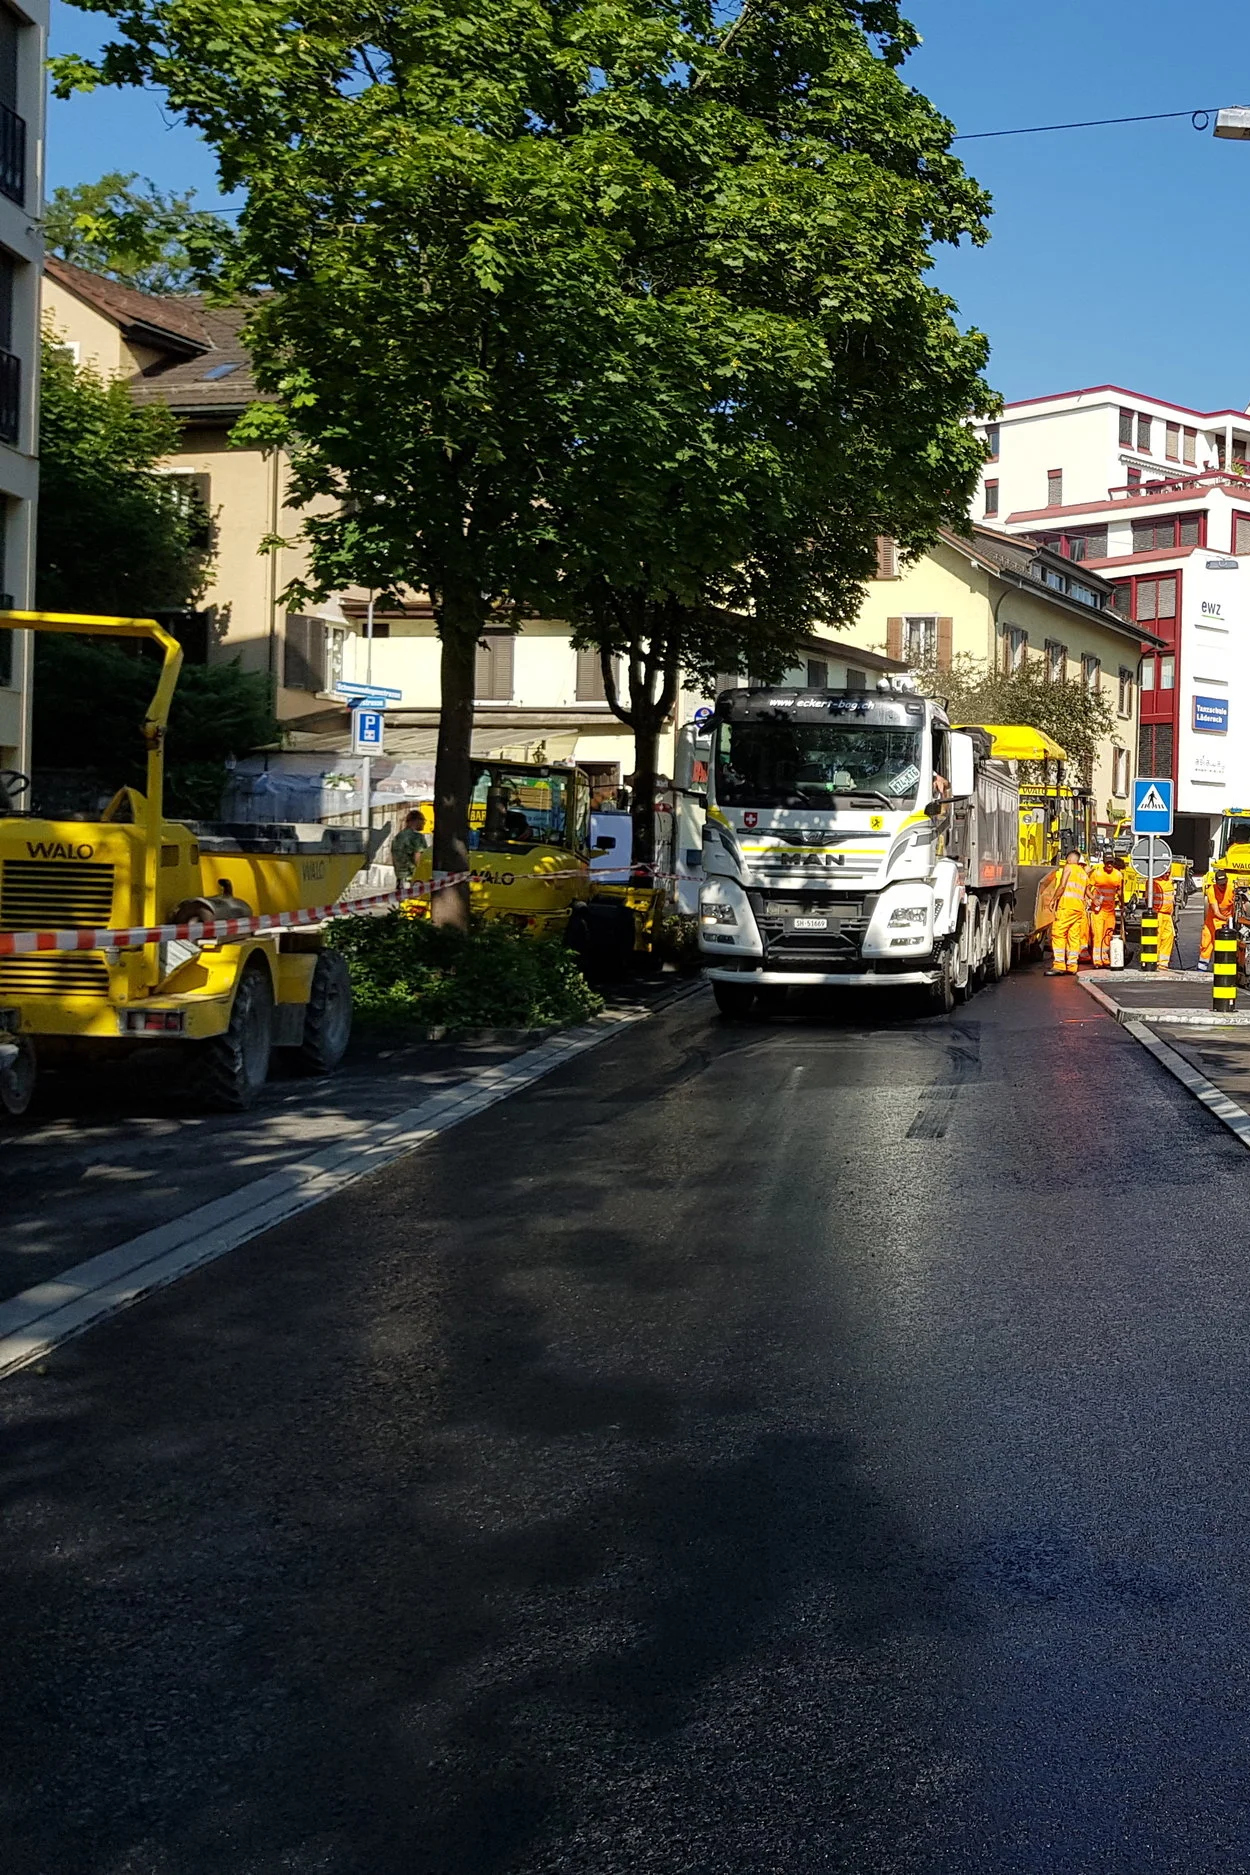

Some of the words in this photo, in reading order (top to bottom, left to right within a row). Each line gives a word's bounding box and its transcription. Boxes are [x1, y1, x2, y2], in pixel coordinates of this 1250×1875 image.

[1201, 601, 1221, 616] ewz
[1196, 704, 1227, 716] Tanzschule
[365, 715, 376, 730] P
[26, 842, 94, 860] WALO
[780, 852, 845, 866] MAN
